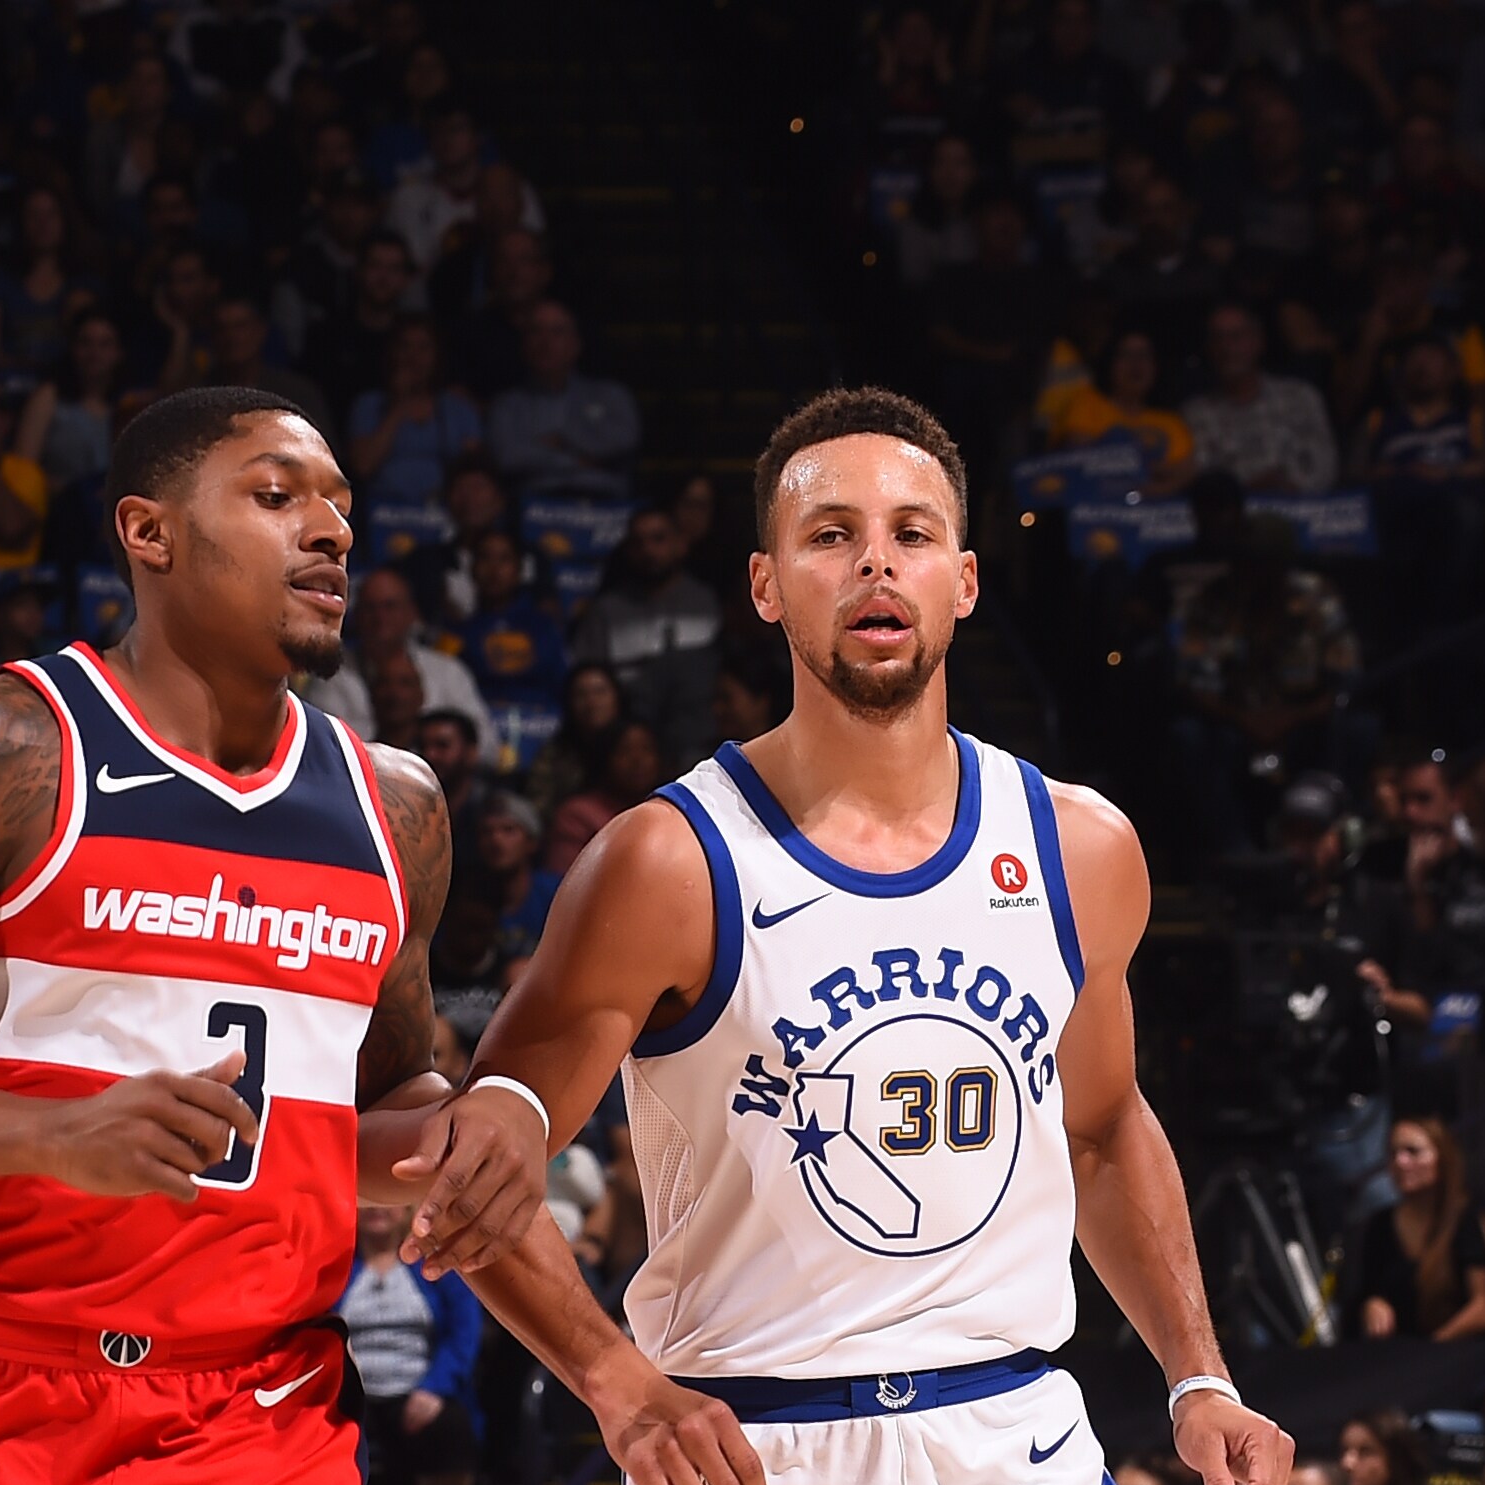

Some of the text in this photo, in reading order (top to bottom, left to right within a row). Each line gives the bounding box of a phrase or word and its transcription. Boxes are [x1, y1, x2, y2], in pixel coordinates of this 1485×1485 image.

[83, 873, 388, 970] washington
[989, 894, 1040, 909] Rakuten
[731, 947, 1056, 1120] WARRIORS
[190, 1000, 272, 1191] 3
[878, 1066, 999, 1157] 30
